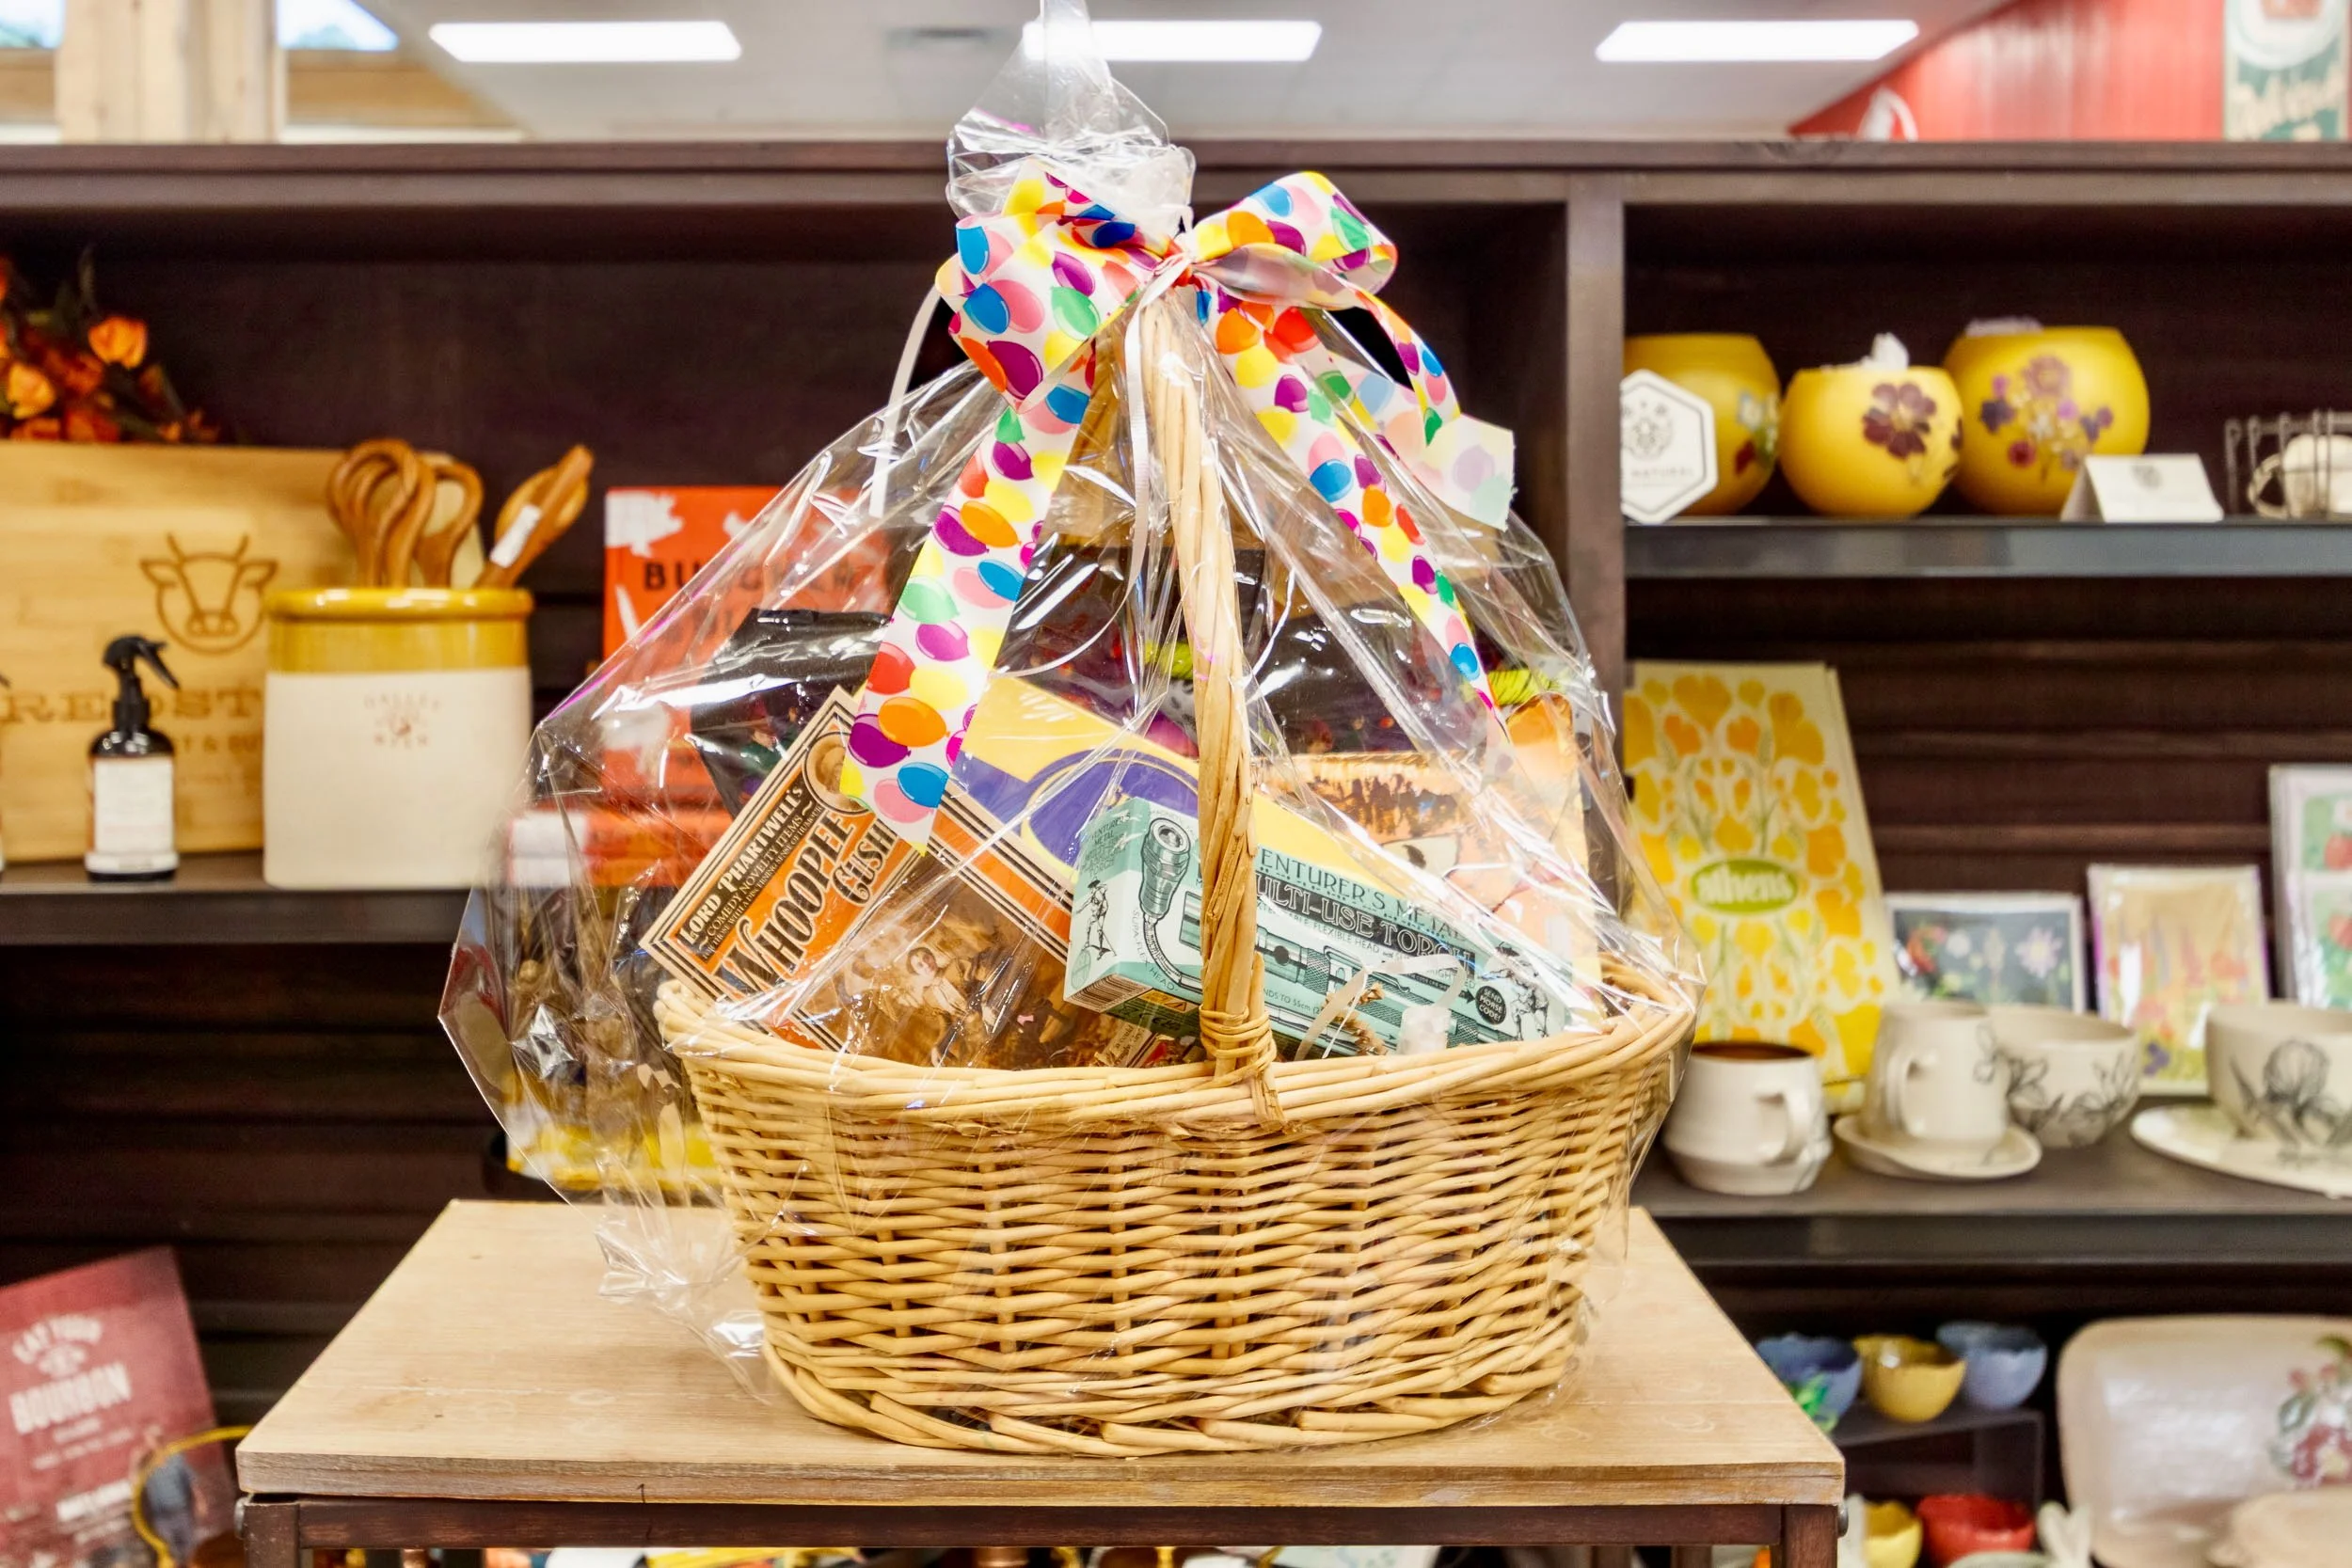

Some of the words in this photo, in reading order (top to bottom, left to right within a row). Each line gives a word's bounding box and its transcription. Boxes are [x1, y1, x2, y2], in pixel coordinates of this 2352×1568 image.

[707, 892, 743, 937] COMEDY
[739, 845, 780, 895] NOVELTY
[776, 815, 804, 849] ITEMS
[1261, 848, 1386, 910] ENTURER'S
[716, 812, 856, 994] WHOOPEE
[1255, 872, 1374, 939] ULTI-USE
[679, 896, 722, 946] LORD
[1313, 922, 1352, 942] FLEXIBLE
[1355, 939, 1380, 953] HEAD
[1149, 967, 1175, 990] HEAD
[1280, 994, 1291, 1004] TO
[1479, 995, 1503, 1013] MORSE
[1484, 989, 1502, 1004] SEND
[1479, 1005, 1502, 1022] CODE!
